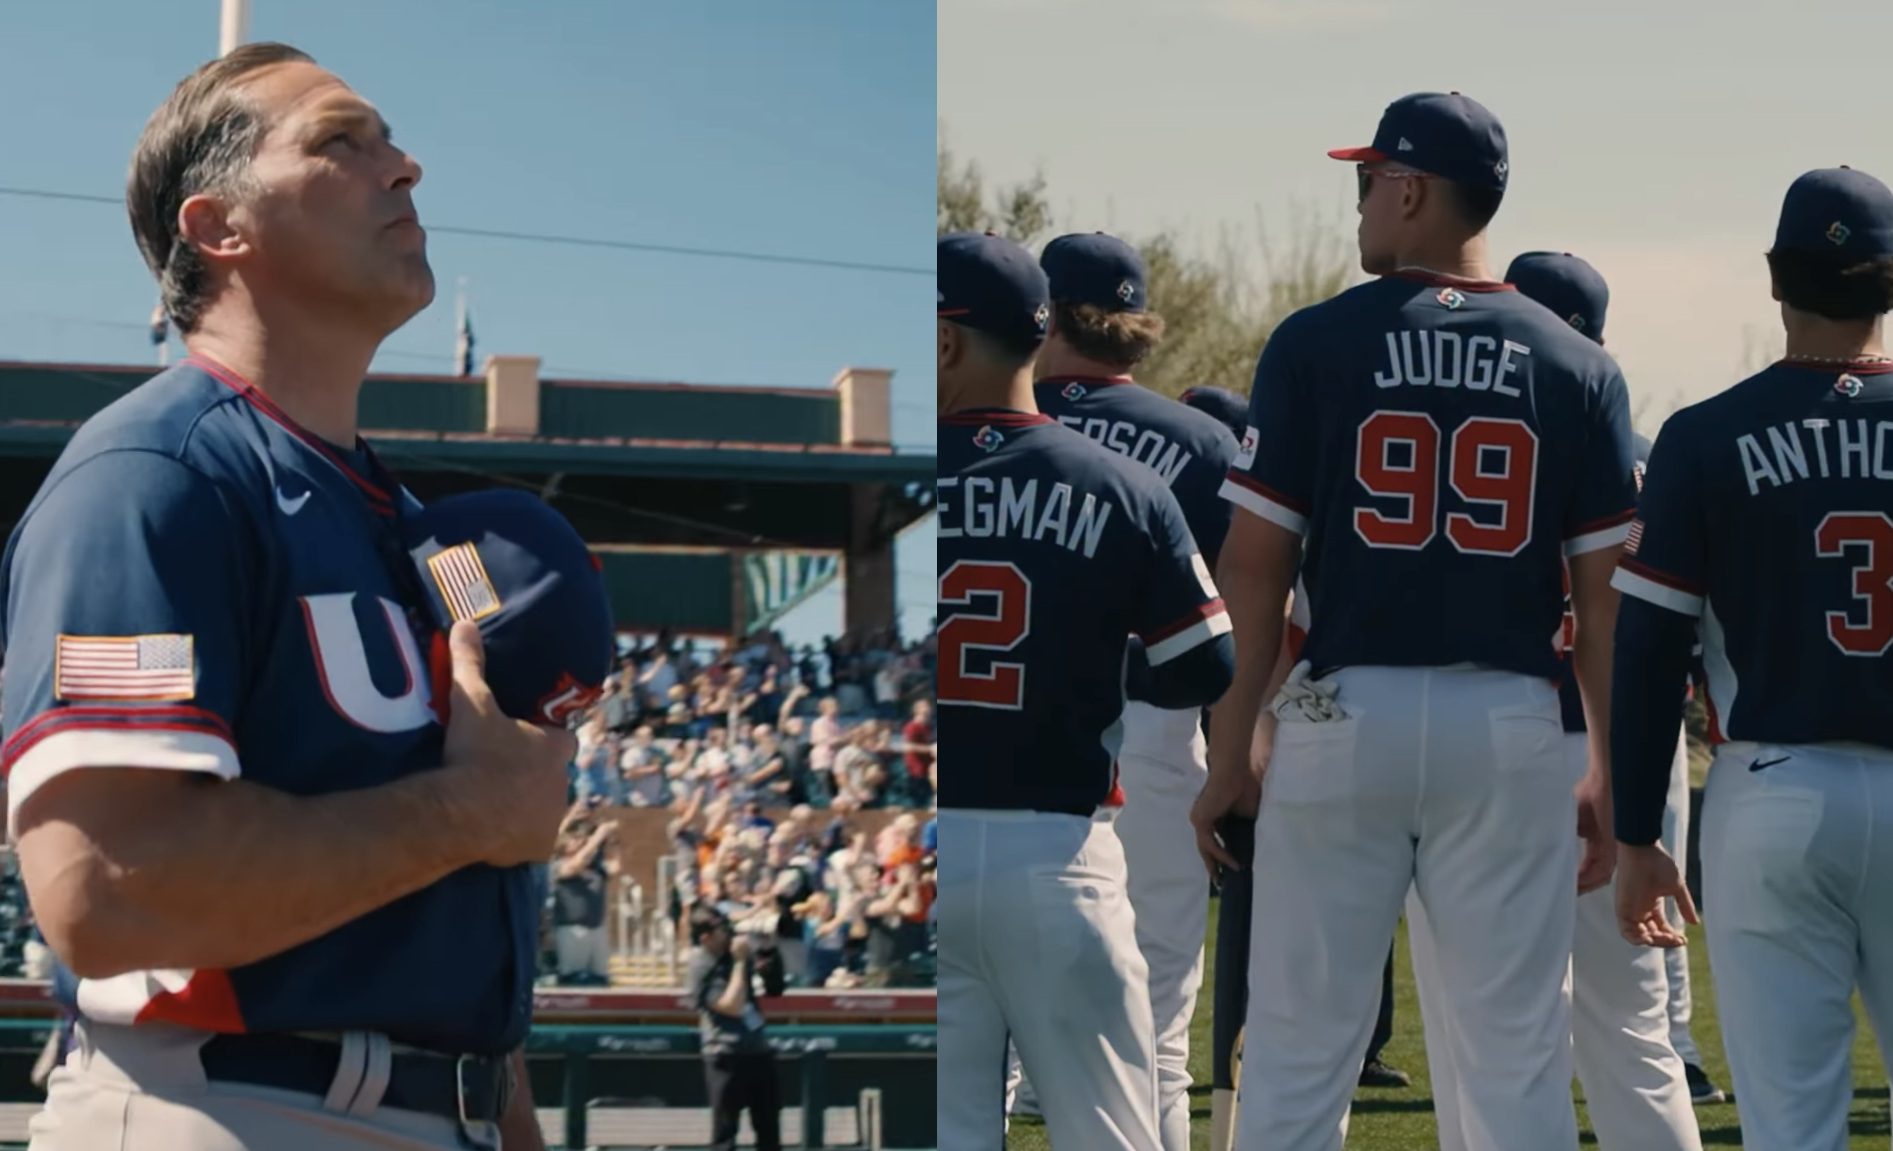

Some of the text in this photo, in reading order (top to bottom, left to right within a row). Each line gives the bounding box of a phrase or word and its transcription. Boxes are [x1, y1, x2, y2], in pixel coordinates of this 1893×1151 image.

[1374, 329, 1531, 398] JUDGE
[1057, 415, 1192, 488] RSON
[1353, 409, 1540, 558] 99
[937, 559, 1032, 710] 2
[1814, 511, 1893, 657] 3
